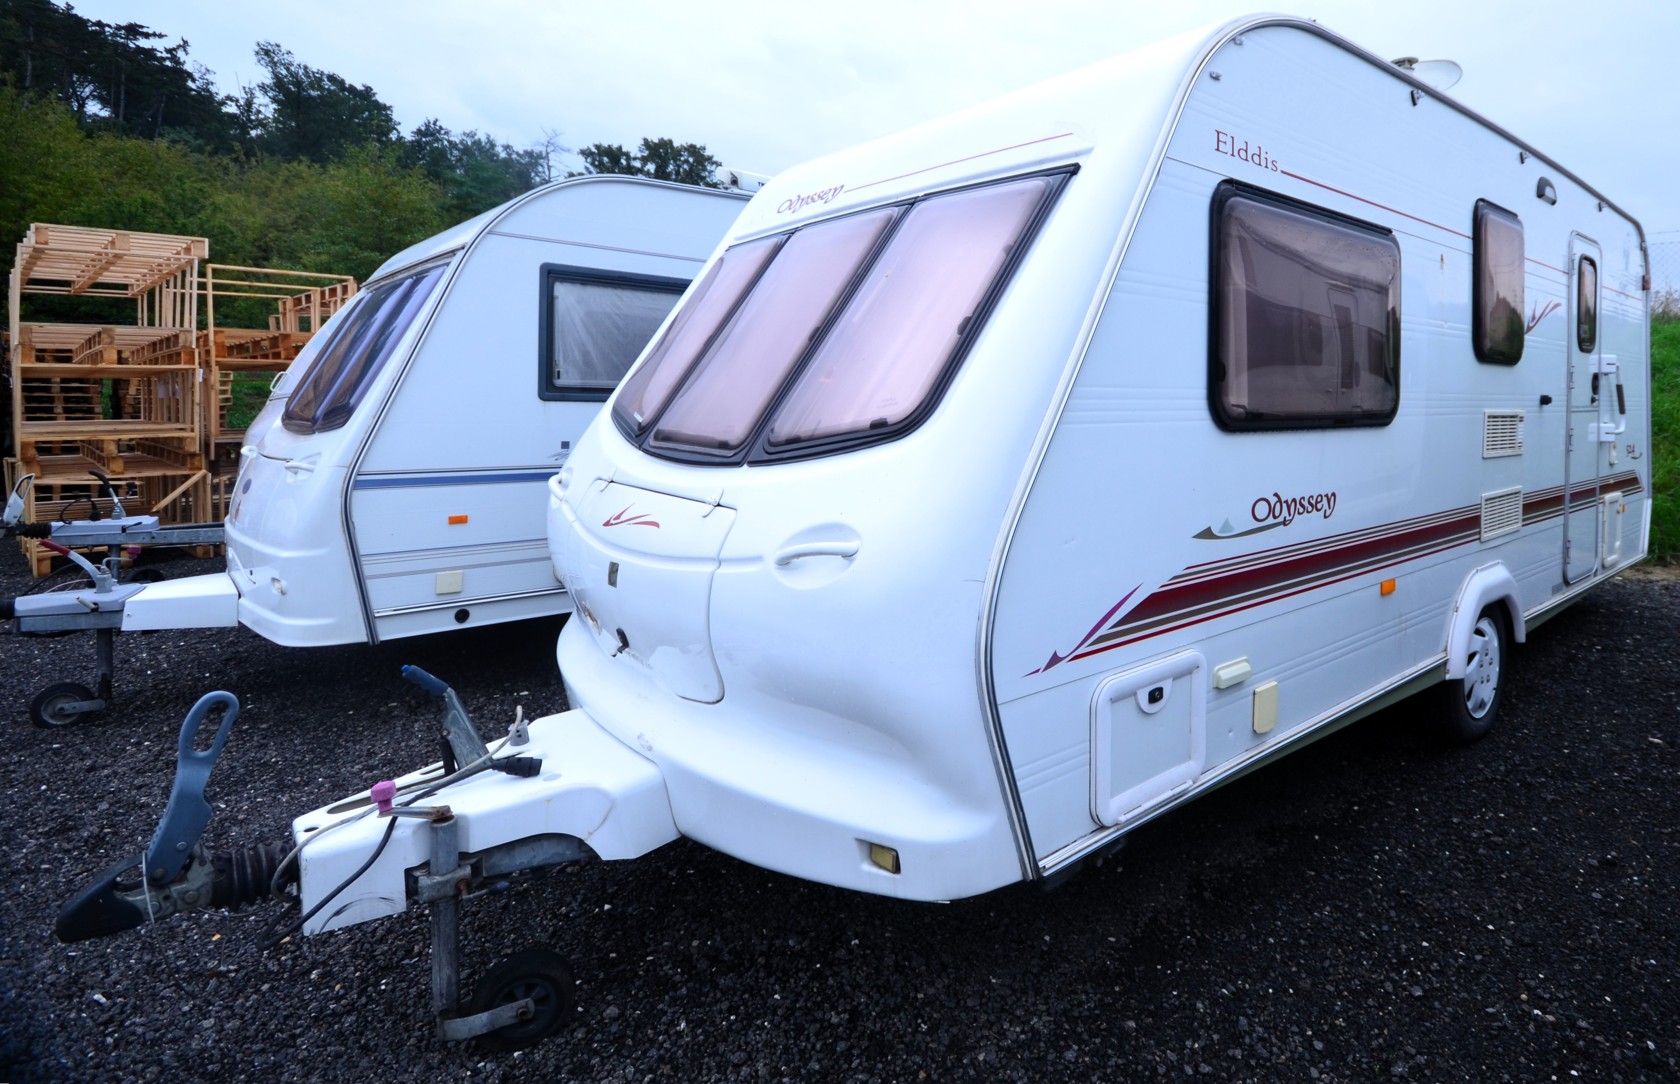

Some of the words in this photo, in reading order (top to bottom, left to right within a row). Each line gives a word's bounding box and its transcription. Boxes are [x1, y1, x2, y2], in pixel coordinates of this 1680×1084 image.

[1214, 129, 1279, 172] Elddis
[777, 184, 844, 214] Odyssey
[1251, 491, 1336, 527] Odyssey
